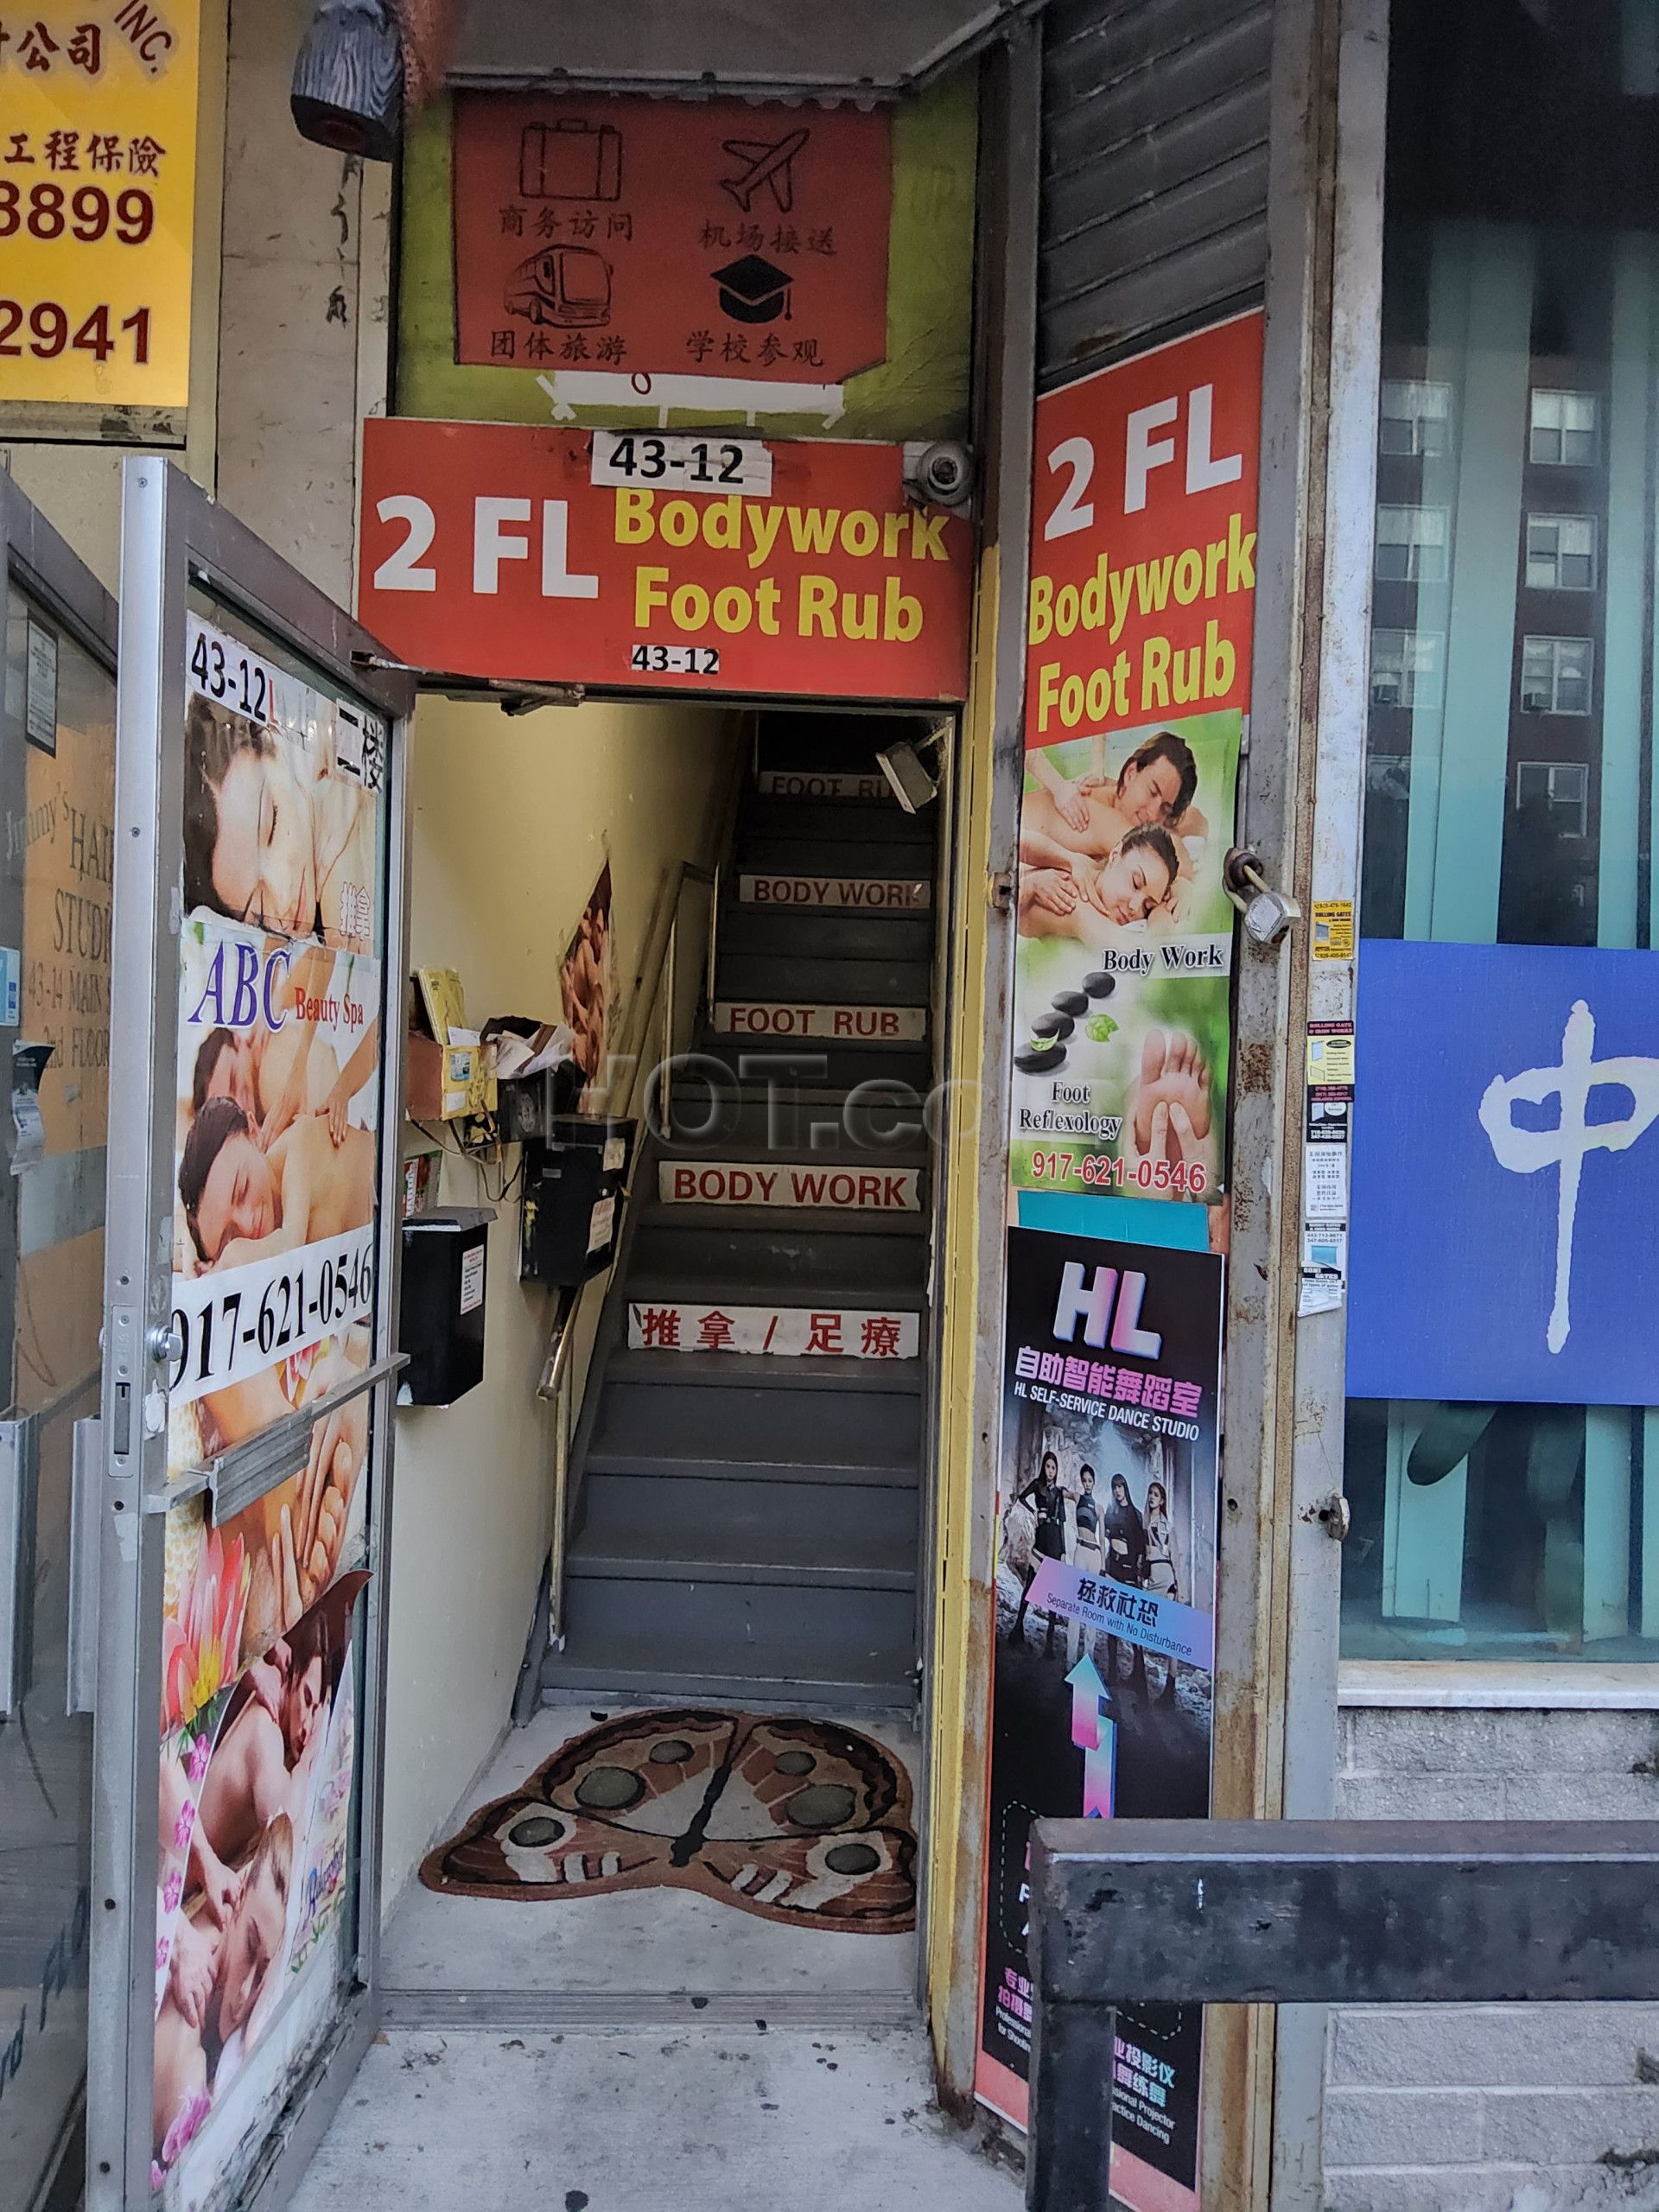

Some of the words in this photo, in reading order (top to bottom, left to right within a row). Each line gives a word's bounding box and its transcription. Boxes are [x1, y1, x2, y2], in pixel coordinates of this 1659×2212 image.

[3, 130, 167, 177] 工程保險
[499, 206, 633, 242] 商务访问
[699, 219, 836, 256] 机场接送
[491, 330, 628, 362] 团体旅游
[686, 331, 824, 367] 学校参观
[608, 438, 743, 485] 43-12
[1045, 436, 1095, 541] 2
[1124, 384, 1242, 514] FL
[373, 494, 436, 592] 2
[473, 497, 598, 599] FL
[614, 487, 950, 569] Bodywork
[1028, 513, 1257, 645] Bodywork
[635, 566, 781, 636] Foot
[798, 575, 924, 642] Rub
[191, 632, 266, 722] 43-12
[632, 645, 720, 675] 43-12
[1038, 649, 1131, 733] Foot
[1141, 620, 1236, 710] Rub
[772, 777, 842, 795] FOOT
[754, 880, 830, 904] BODY
[838, 883, 920, 906] WORK
[1103, 949, 1154, 976] Body
[1160, 944, 1223, 968] Work
[188, 939, 291, 1031] ABC
[295, 987, 340, 1032] Beauty
[343, 994, 363, 1033] Spa
[730, 1007, 815, 1033] FOOT
[834, 1011, 899, 1036] RUB
[1052, 1082, 1089, 1103] Foot
[1020, 1109, 1122, 1138] Reflexology
[674, 1169, 777, 1202] BODY
[791, 1173, 907, 1206] WORK
[1032, 1151, 1206, 1193] 917-621-0546
[1478, 999, 1659, 1354] 中
[1053, 1261, 1162, 1360] HL
[1015, 1345, 1203, 1418] 自助智能舞蹈室
[1014, 1382, 1027, 1398] HL
[1030, 1385, 1105, 1418] SELF-SERVICE
[1108, 1405, 1150, 1430] DANCE
[1152, 1415, 1200, 1441] STUDIO
[1047, 1592, 1080, 1615] Separate
[1082, 1606, 1104, 1624] Room
[1107, 1618, 1124, 1632] with
[1126, 1624, 1138, 1637] No
[1141, 1627, 1192, 1656] Disturbance
[1077, 1577, 1159, 1627] 拯救社恐
[1005, 1967, 1034, 2001] 专业
[1136, 2114, 1170, 2145] Dancing
[1138, 2100, 1175, 2130] Projector
